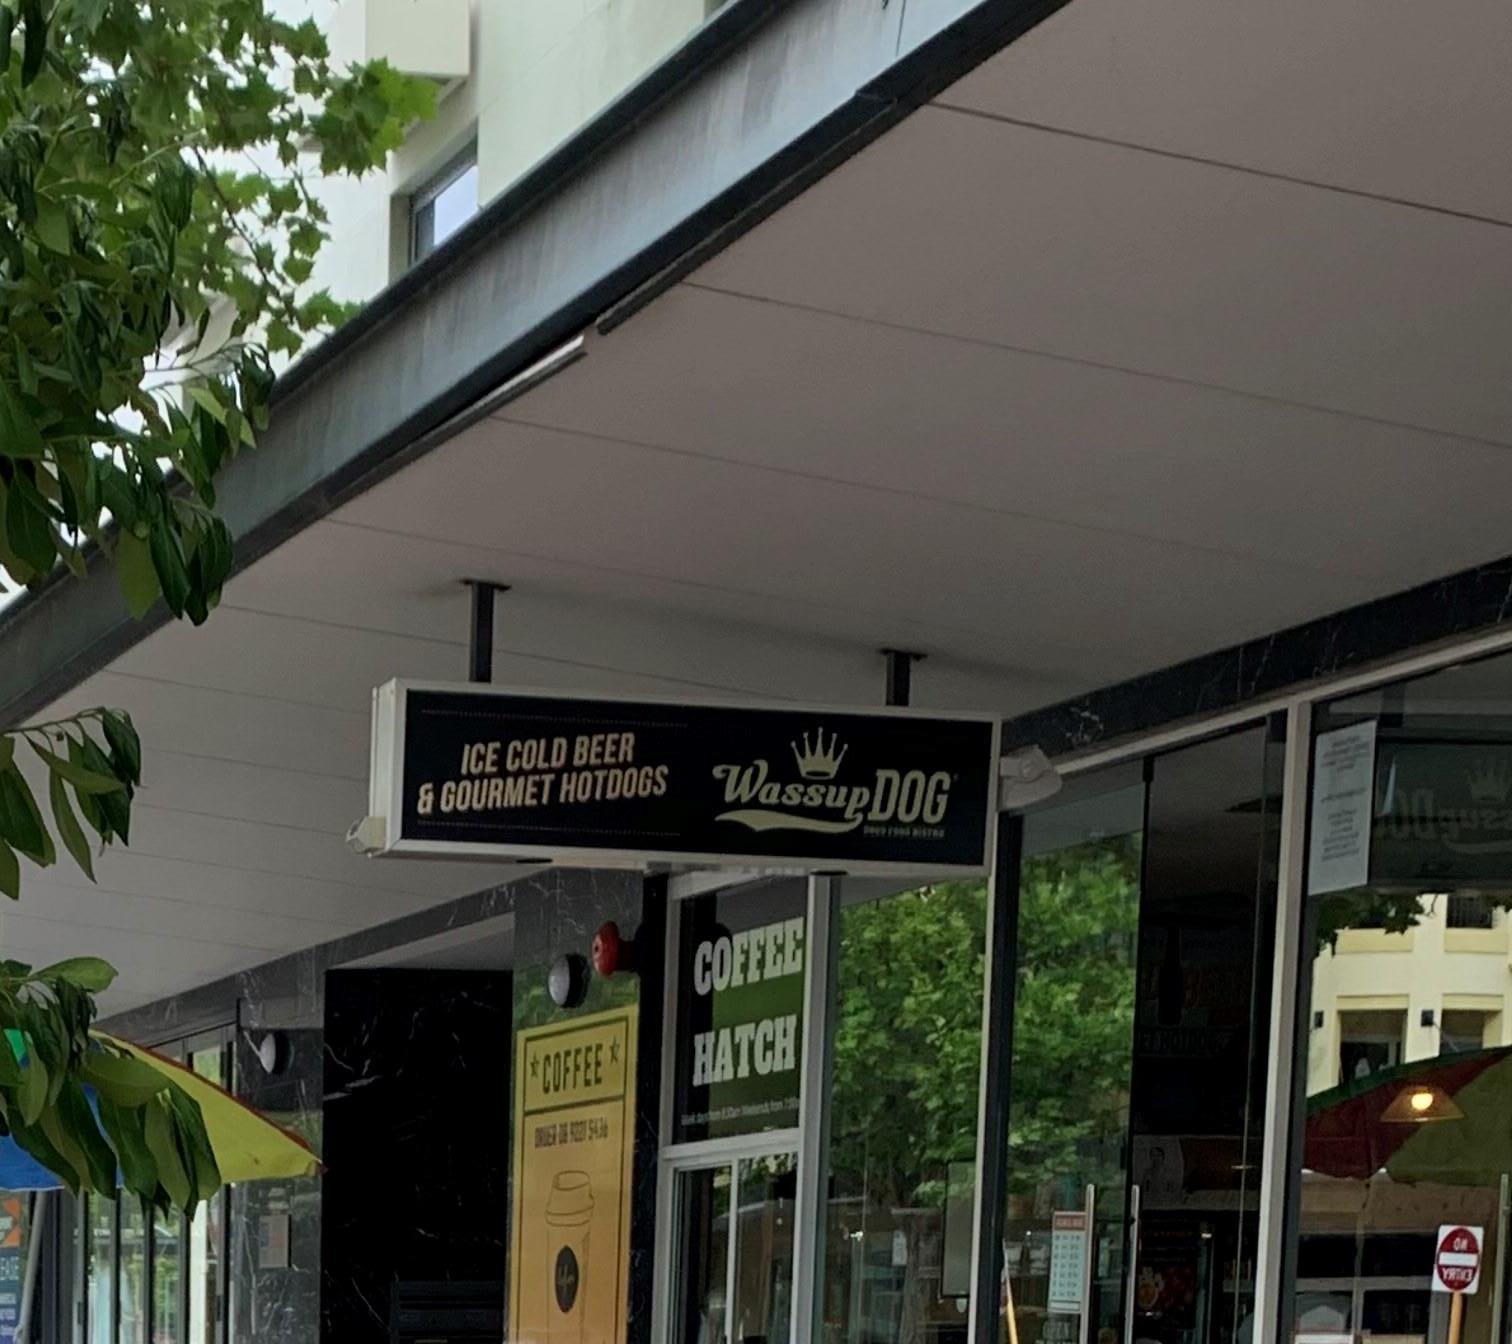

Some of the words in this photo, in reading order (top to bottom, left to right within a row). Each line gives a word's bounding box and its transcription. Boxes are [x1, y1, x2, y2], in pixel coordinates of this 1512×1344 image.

[460, 741, 501, 776] ICE
[506, 736, 568, 772] COLD
[573, 731, 636, 767] BEER
[416, 782, 434, 816] &
[439, 773, 556, 813] GOURMET
[559, 764, 670, 804] HOTDOGS
[693, 916, 804, 996] COFFEE
[543, 1043, 603, 1095] COFFEE
[692, 1014, 797, 1087] HATCH
